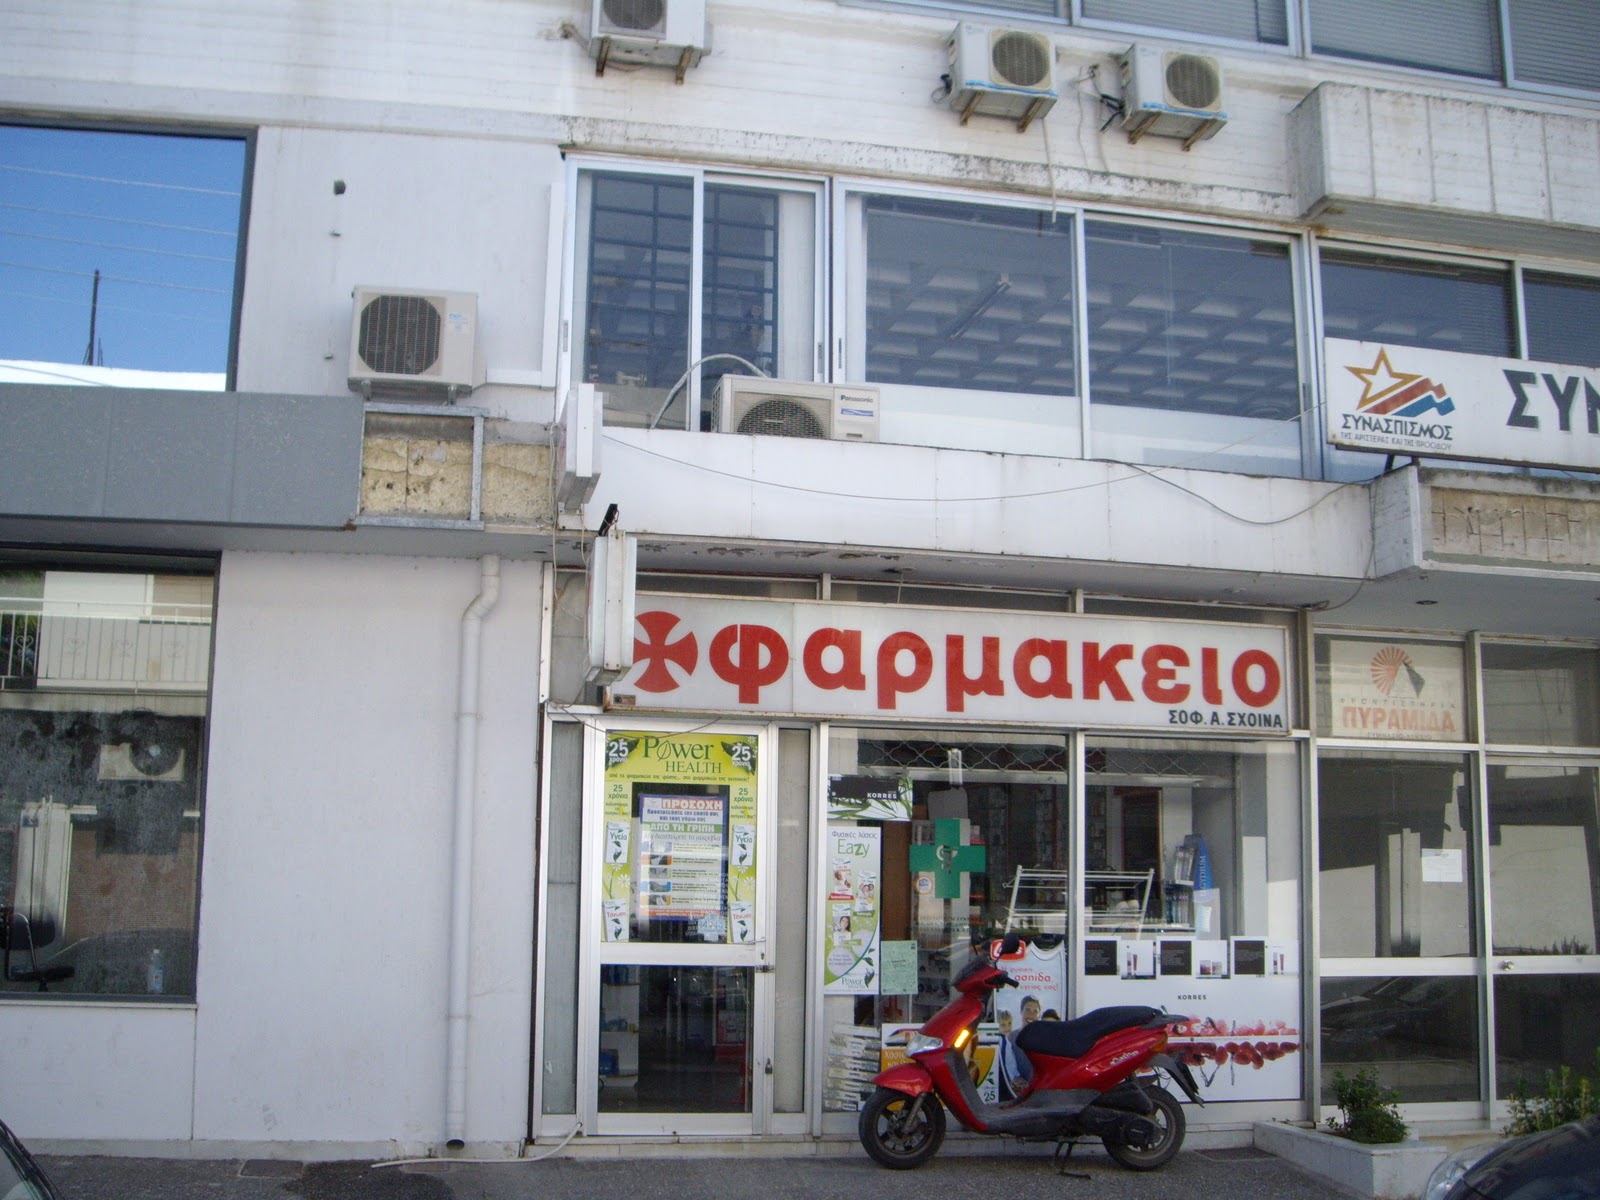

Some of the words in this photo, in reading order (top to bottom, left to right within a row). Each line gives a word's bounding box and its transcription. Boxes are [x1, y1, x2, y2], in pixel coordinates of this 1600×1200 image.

[841, 395, 874, 403] Panasonic
[1342, 413, 1453, 441] ΣΥΝΑΣΠΙΣΜΟΣ
[1341, 431, 1352, 440] ΤΗΣ
[1355, 434, 1389, 444] ΑΡΙΣΤΕΡΑΣ
[1392, 437, 1403, 445] ΚΑΙ
[1405, 438, 1415, 447] ΤΗΣ
[1416, 440, 1452, 451] ΠΡΟΟΔΟΥ
[1227, 712, 1283, 729] ΣΧΟΙΝΑ
[1342, 705, 1457, 733] ΠΥΡΑΜΙΔΑ
[609, 741, 629, 758] 25
[643, 735, 714, 761] Power
[731, 746, 751, 761] 25
[665, 761, 722, 773] HEALTH
[738, 788, 749, 796] 25
[662, 799, 723, 810] ΠΡΟΣΟΧΗ
[650, 823, 669, 831] ΑΠΟ
[837, 838, 870, 858] Eazy
[983, 1090, 996, 1102] 25
